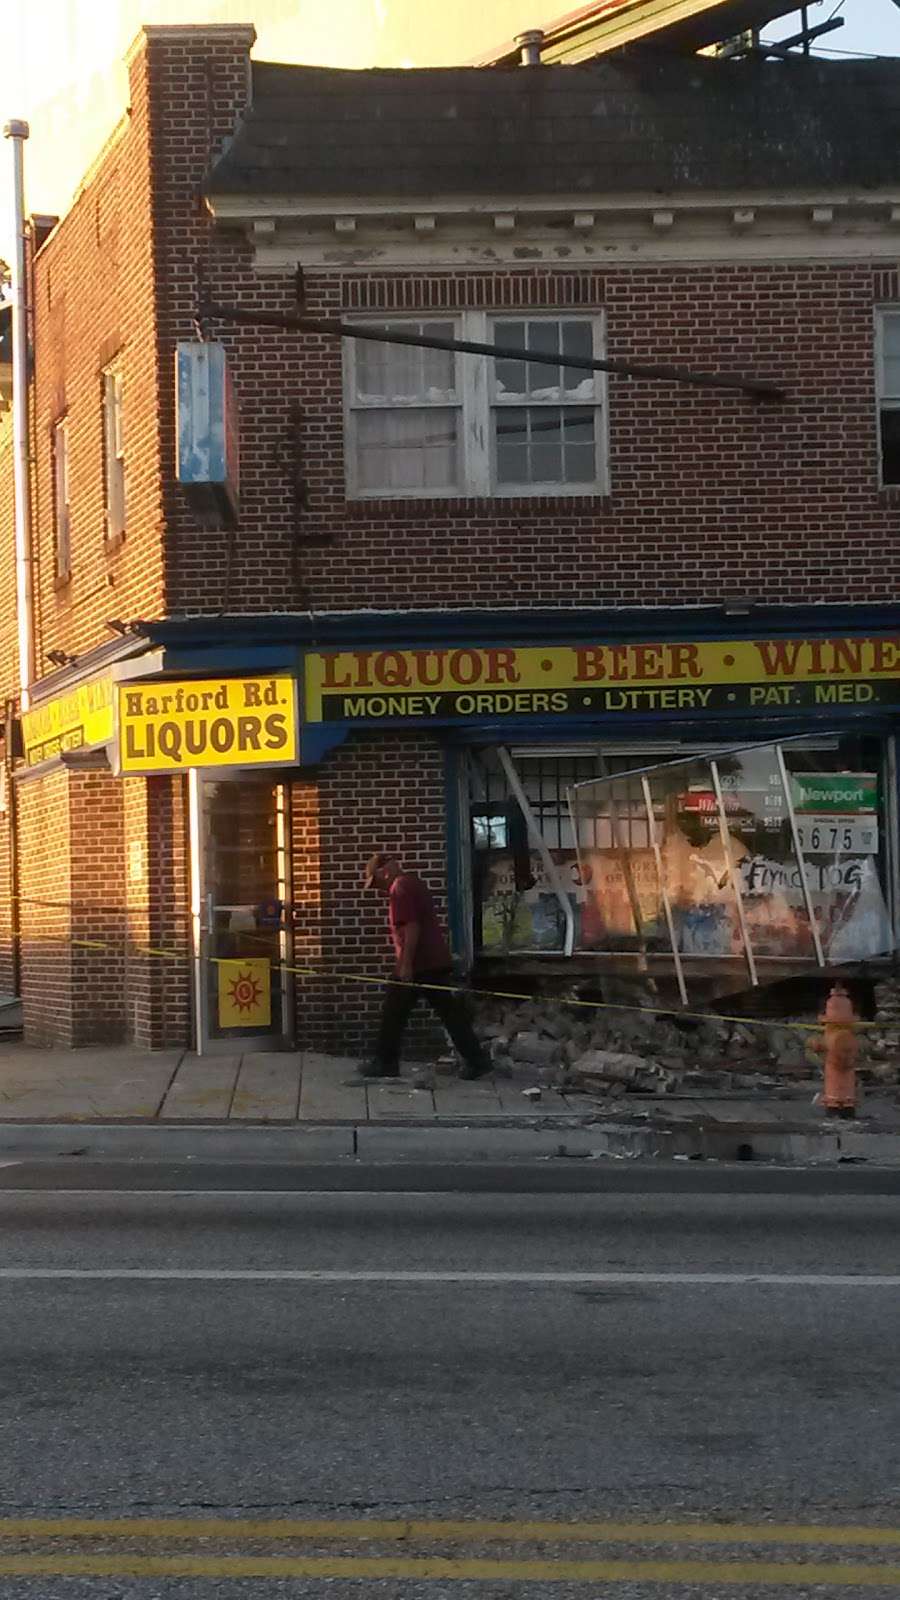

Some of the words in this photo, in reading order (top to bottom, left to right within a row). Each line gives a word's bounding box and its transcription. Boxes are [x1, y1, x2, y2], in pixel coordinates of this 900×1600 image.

[320, 648, 521, 688] LIQUOR
[572, 643, 704, 681] BEER
[753, 637, 900, 675] WINE
[125, 684, 229, 717] Harford
[243, 680, 288, 708] Rd.
[343, 695, 442, 717] MONEY
[455, 692, 569, 714] ORDERS
[751, 685, 800, 705] PAT.
[815, 683, 880, 704] MED.
[125, 712, 289, 762] LIQUORS
[799, 786, 865, 804] Newport
